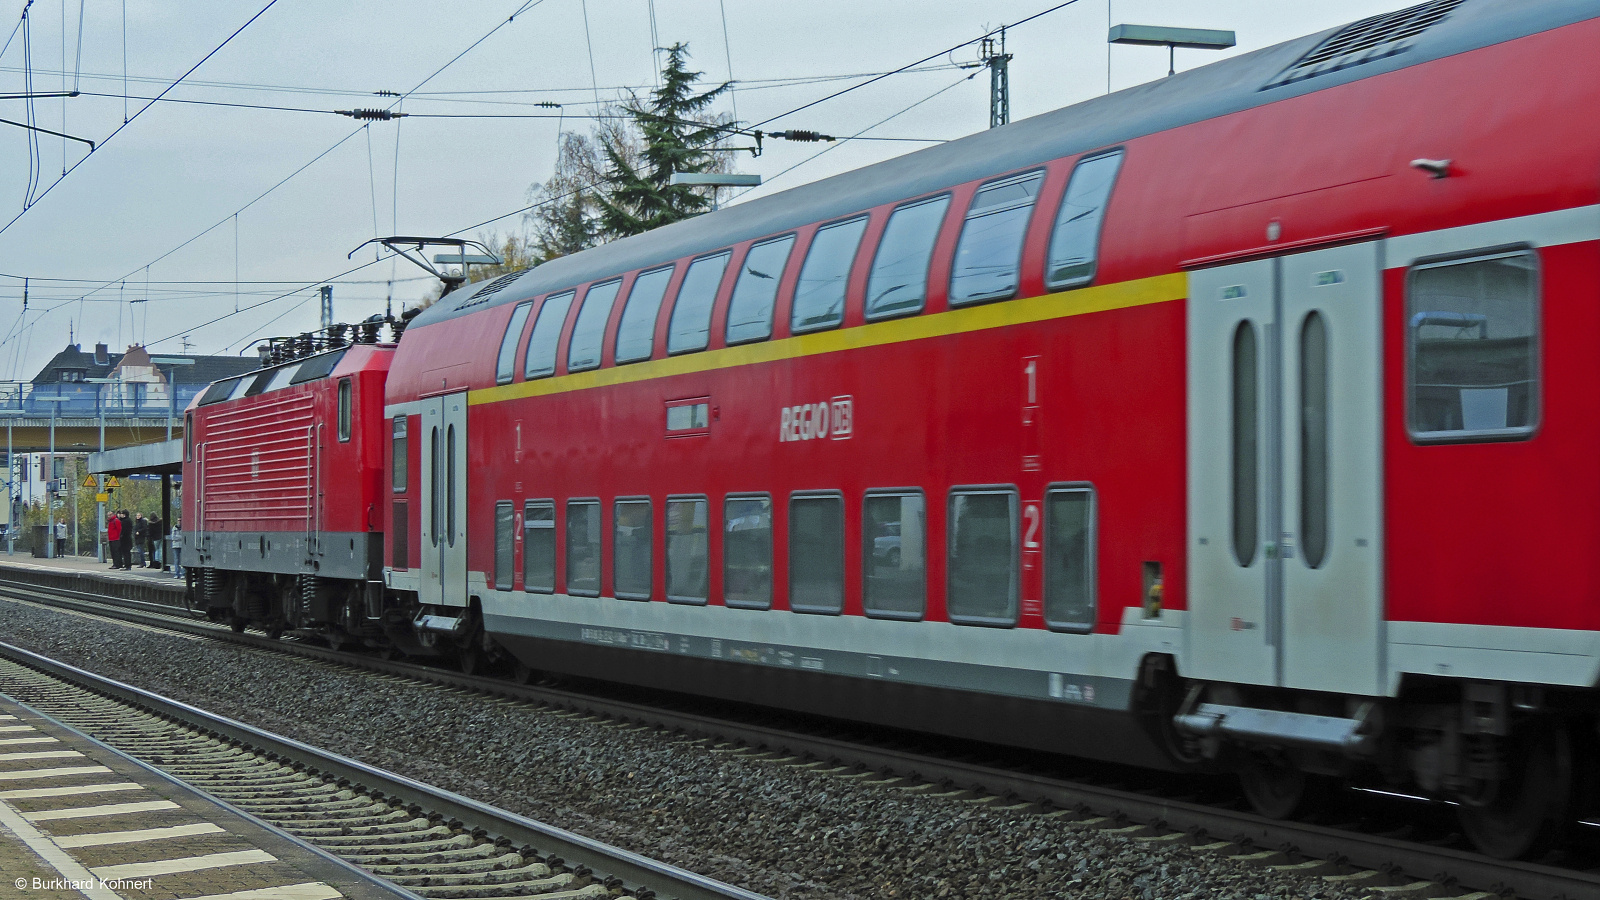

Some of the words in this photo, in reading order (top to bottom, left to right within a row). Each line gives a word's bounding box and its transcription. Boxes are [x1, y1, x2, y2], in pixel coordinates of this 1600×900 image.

[1024, 360, 1036, 404] 1
[515, 422, 521, 450] 1
[779, 401, 829, 442] REGIO
[59, 478, 67, 490] H
[515, 512, 521, 541] 2
[1024, 504, 1039, 548] 2
